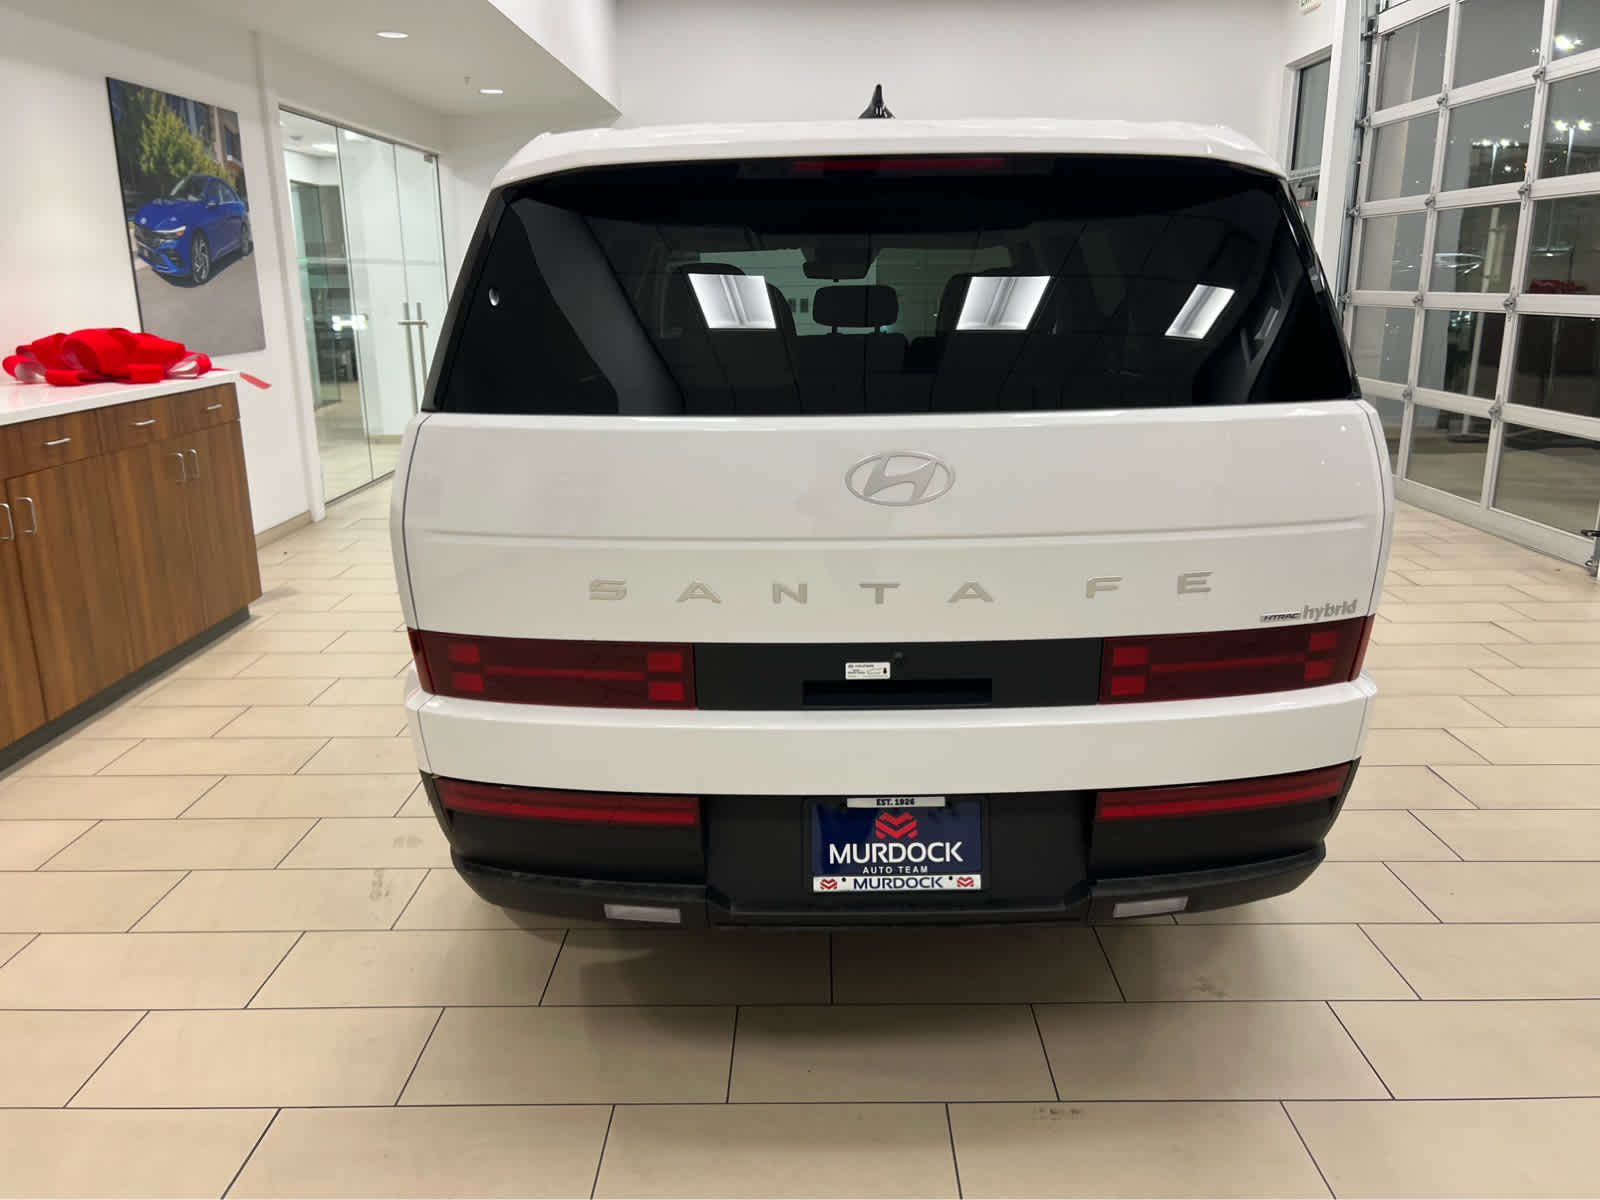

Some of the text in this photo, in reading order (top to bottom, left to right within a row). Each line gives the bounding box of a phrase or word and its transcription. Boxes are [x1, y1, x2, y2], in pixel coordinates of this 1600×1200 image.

[589, 571, 1213, 604] SANTA FE
[1302, 599, 1358, 621] hybrid
[876, 798, 894, 806] EST.
[829, 841, 963, 865] MURDOCK
[862, 865, 929, 874] AUTO TEAM
[853, 876, 944, 890] MURDOCK
